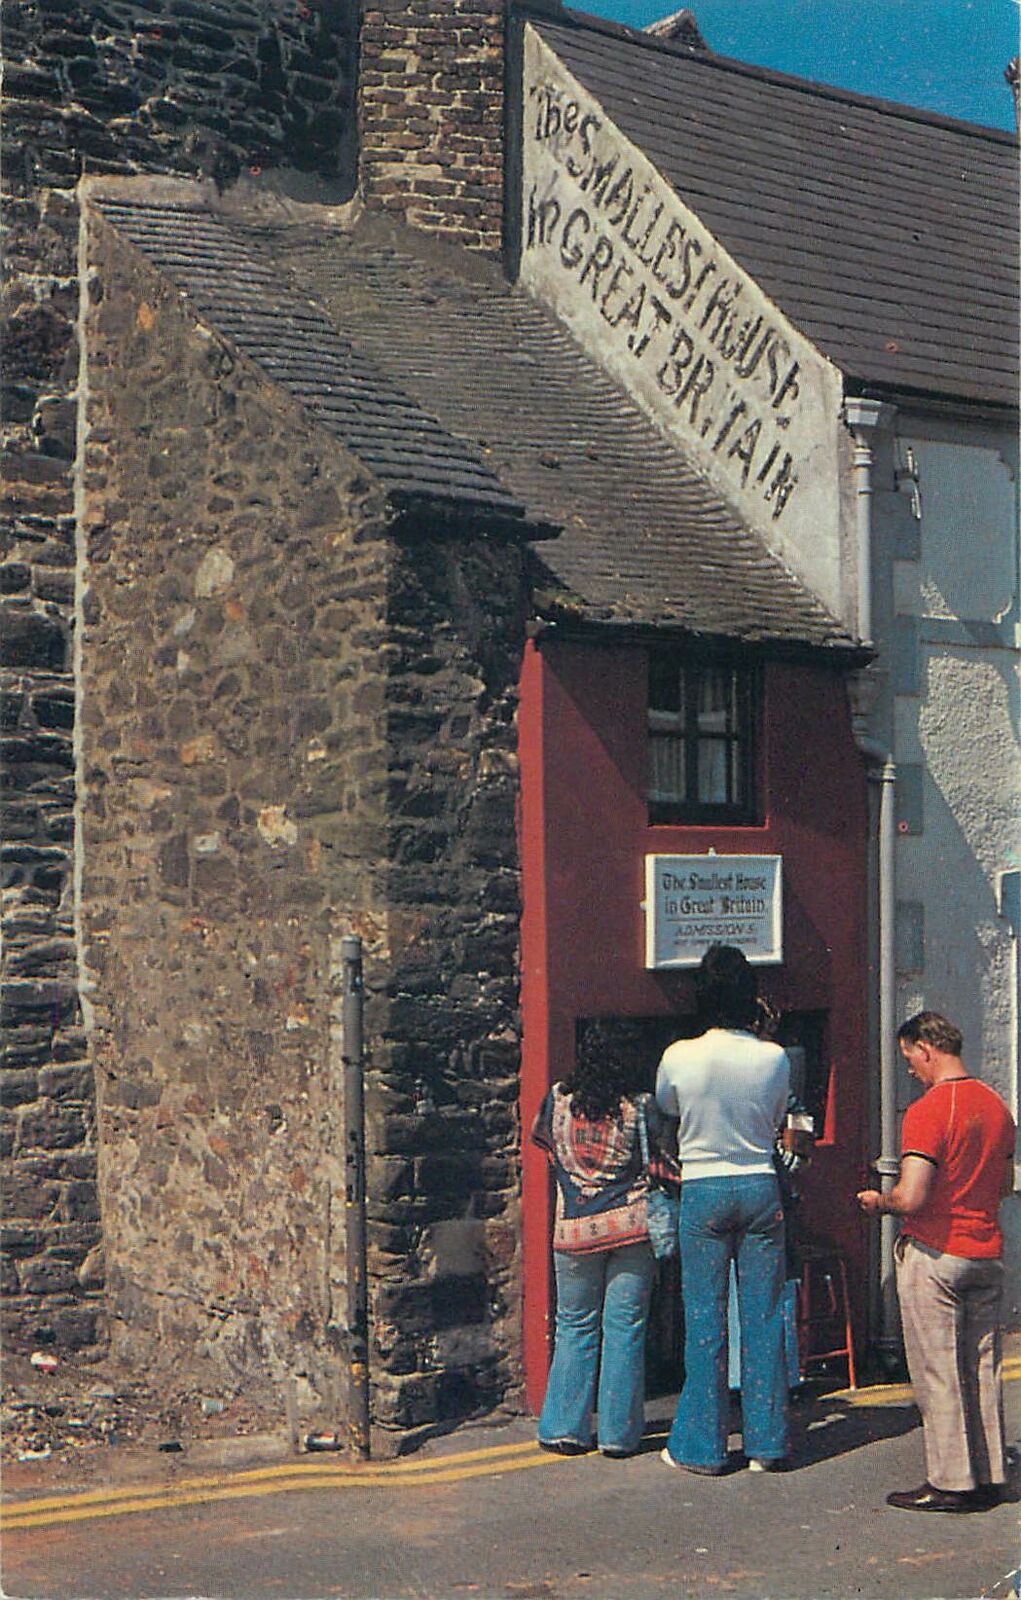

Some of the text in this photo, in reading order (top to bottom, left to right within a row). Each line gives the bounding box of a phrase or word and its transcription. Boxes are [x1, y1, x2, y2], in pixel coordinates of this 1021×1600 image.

[560, 208, 673, 360] GREAT
[662, 872, 686, 890] The
[680, 896, 714, 915] Great
[720, 895, 765, 914] Britain
